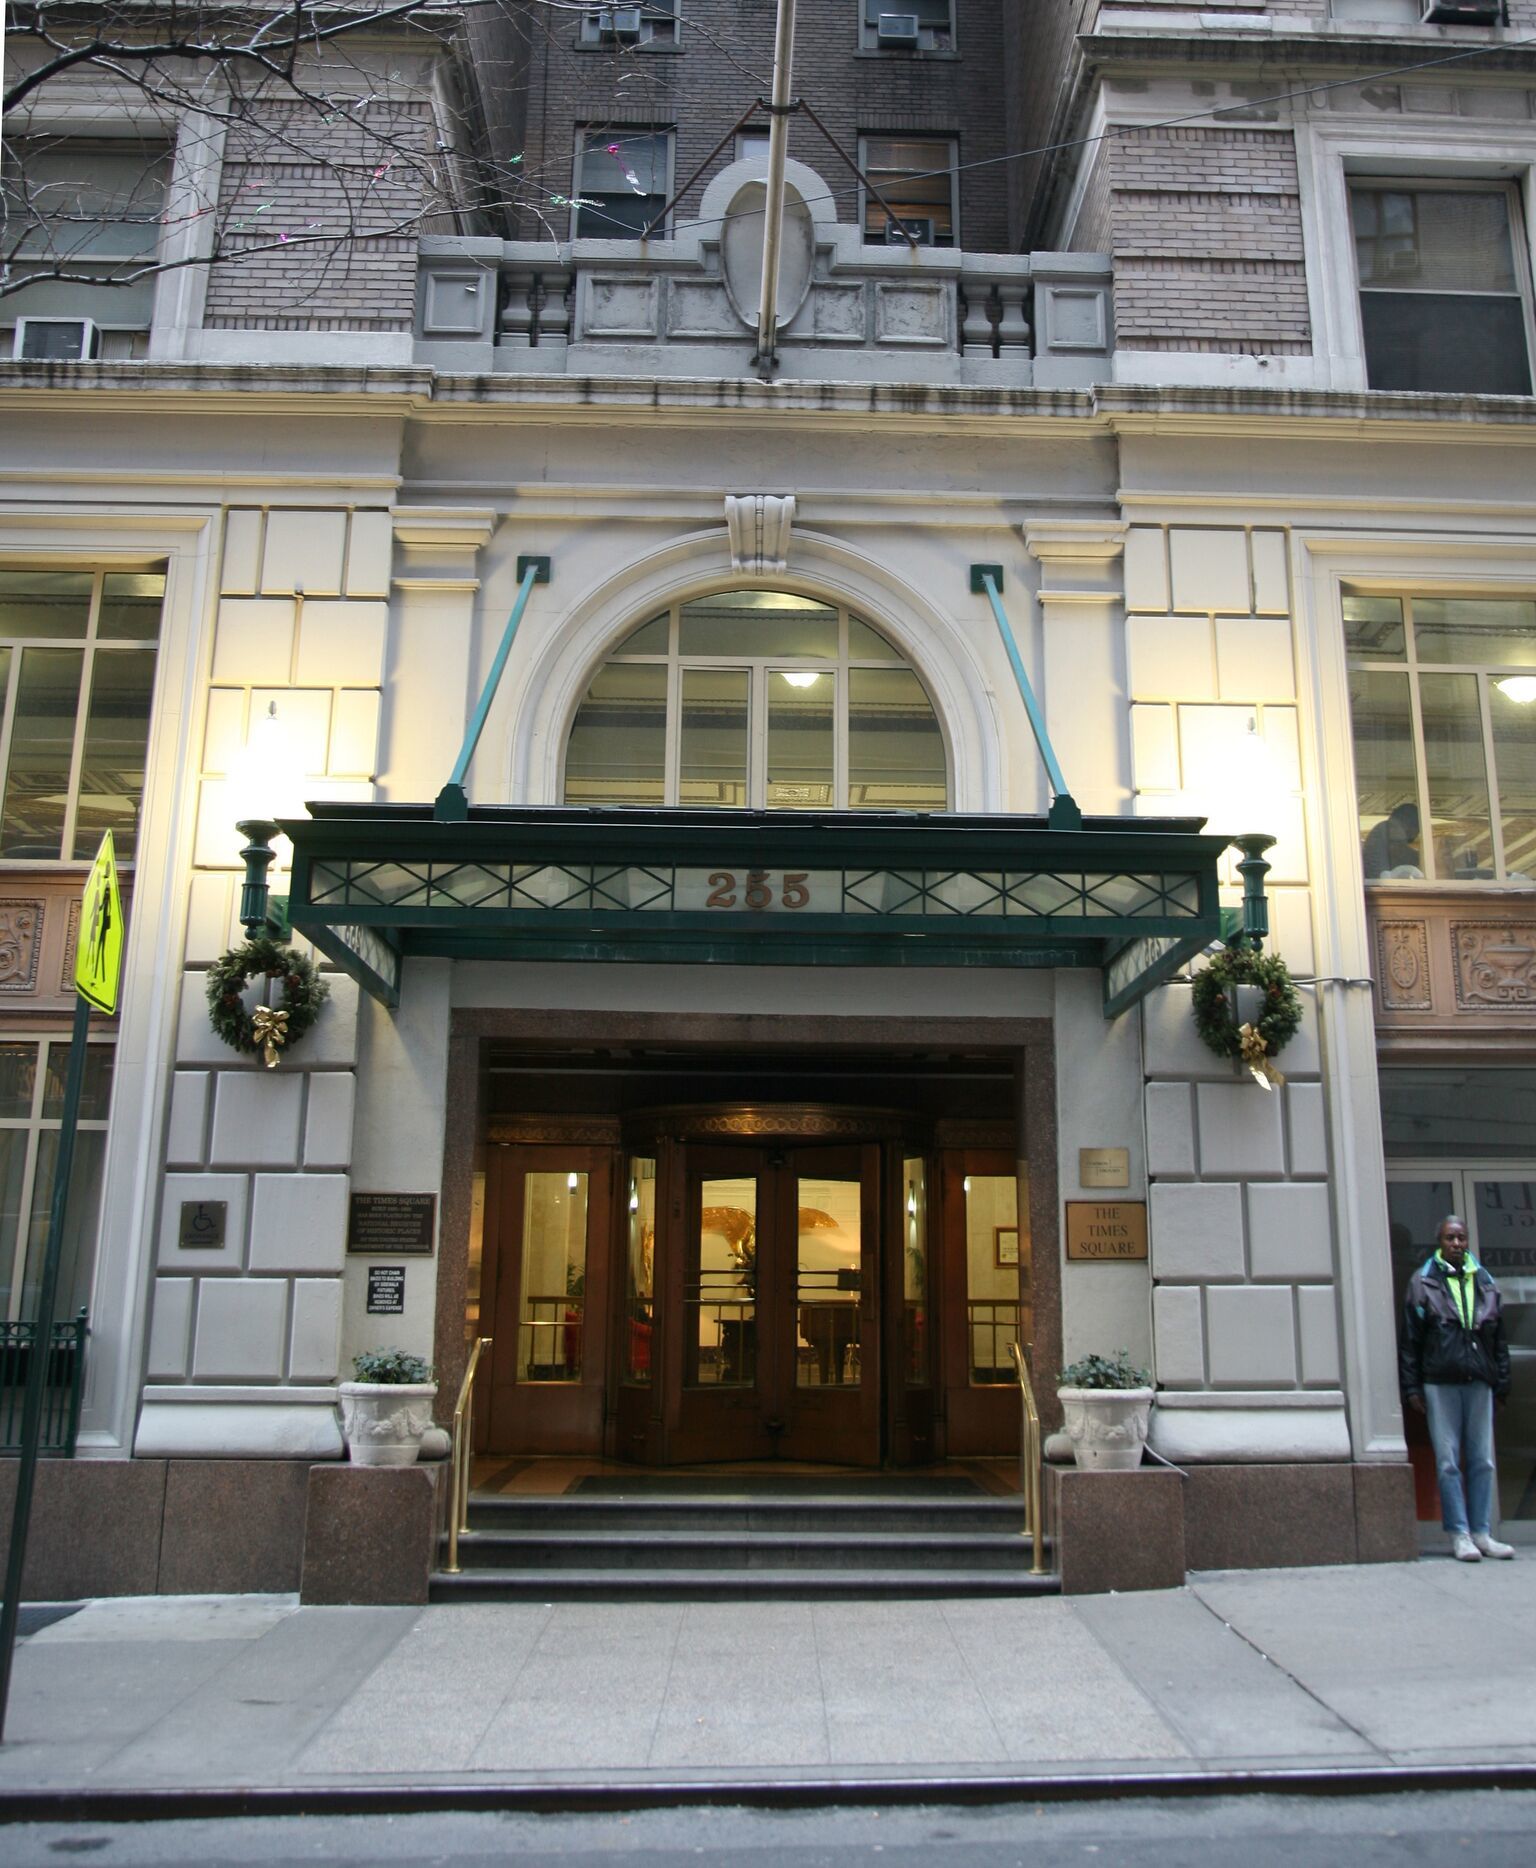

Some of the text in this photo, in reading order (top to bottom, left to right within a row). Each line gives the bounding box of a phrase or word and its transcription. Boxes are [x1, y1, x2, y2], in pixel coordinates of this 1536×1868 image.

[705, 871, 810, 909] 255
[355, 1196, 431, 1207] THE TIMES SQUARE
[1094, 1207, 1120, 1219] THE
[1087, 1224, 1129, 1237] TIMES
[1080, 1241, 1136, 1256] SQUARE
